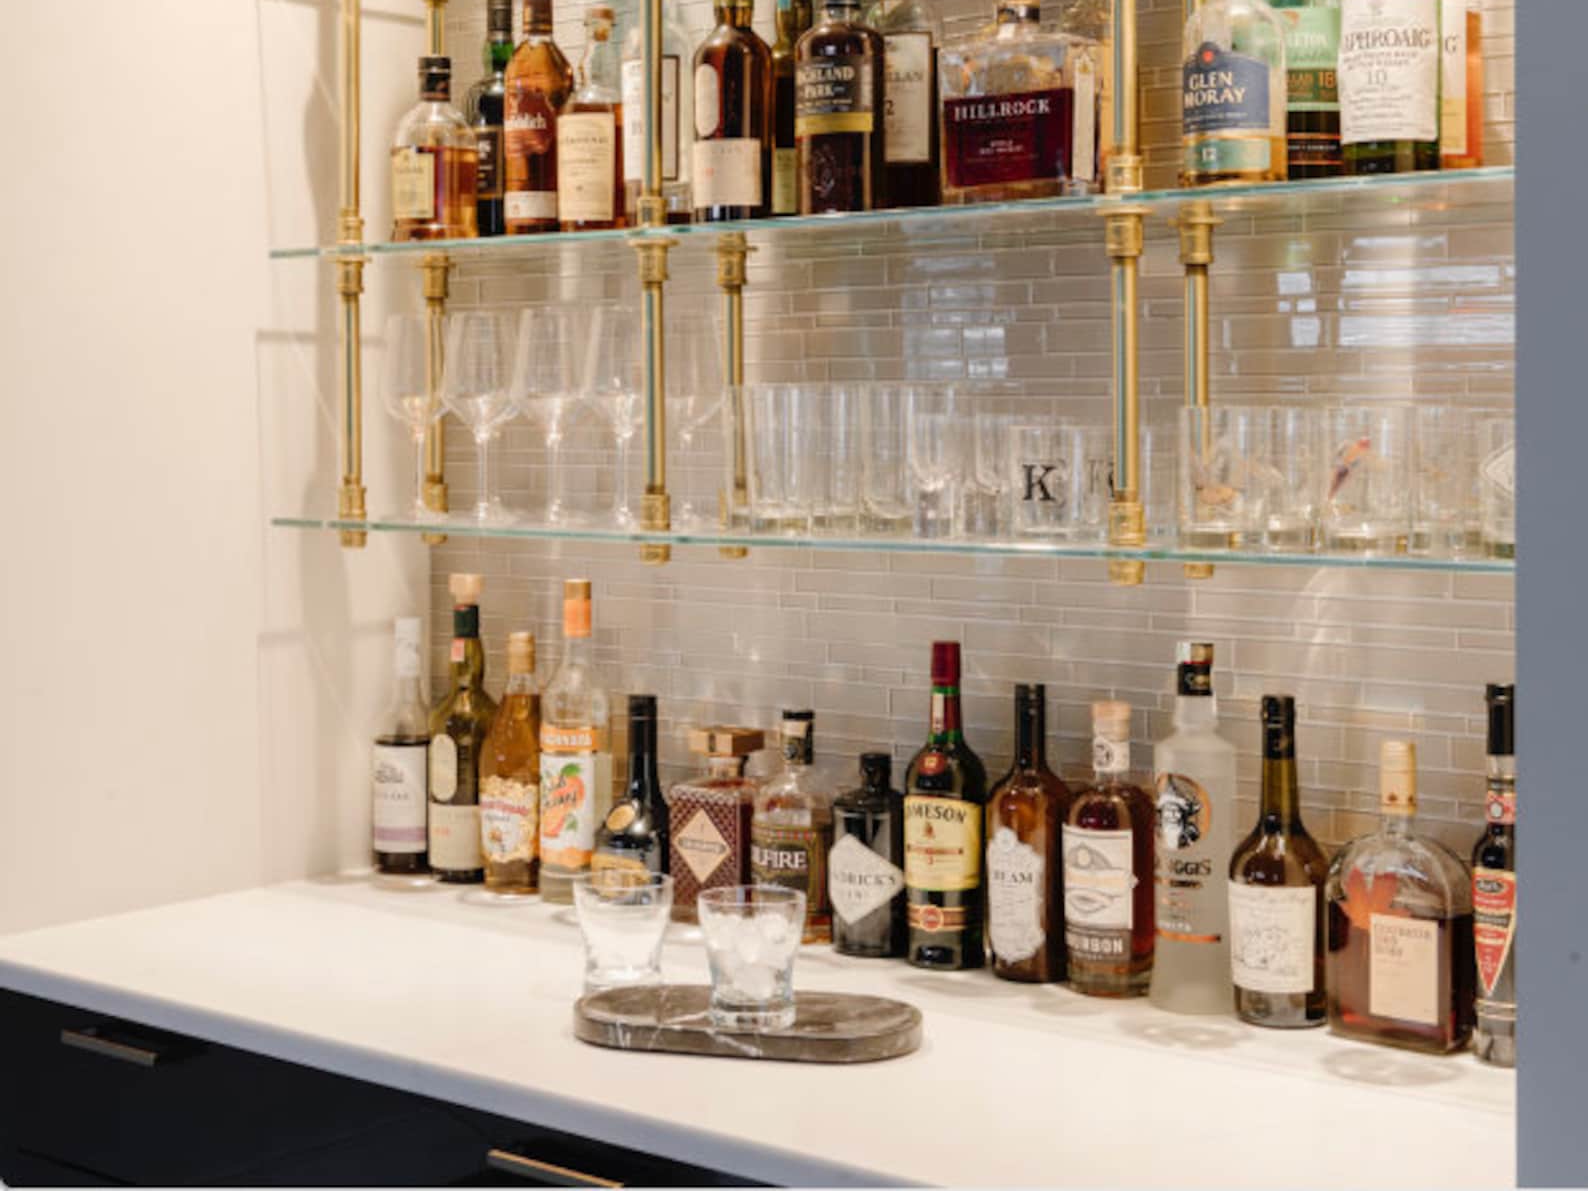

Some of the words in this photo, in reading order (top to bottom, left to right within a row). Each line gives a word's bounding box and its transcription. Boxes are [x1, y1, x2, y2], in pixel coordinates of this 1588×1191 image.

[1189, 71, 1233, 91] GLEN
[1184, 88, 1247, 108] MORAY
[954, 97, 1051, 122] HILLROCK
[1021, 463, 1056, 501] K
